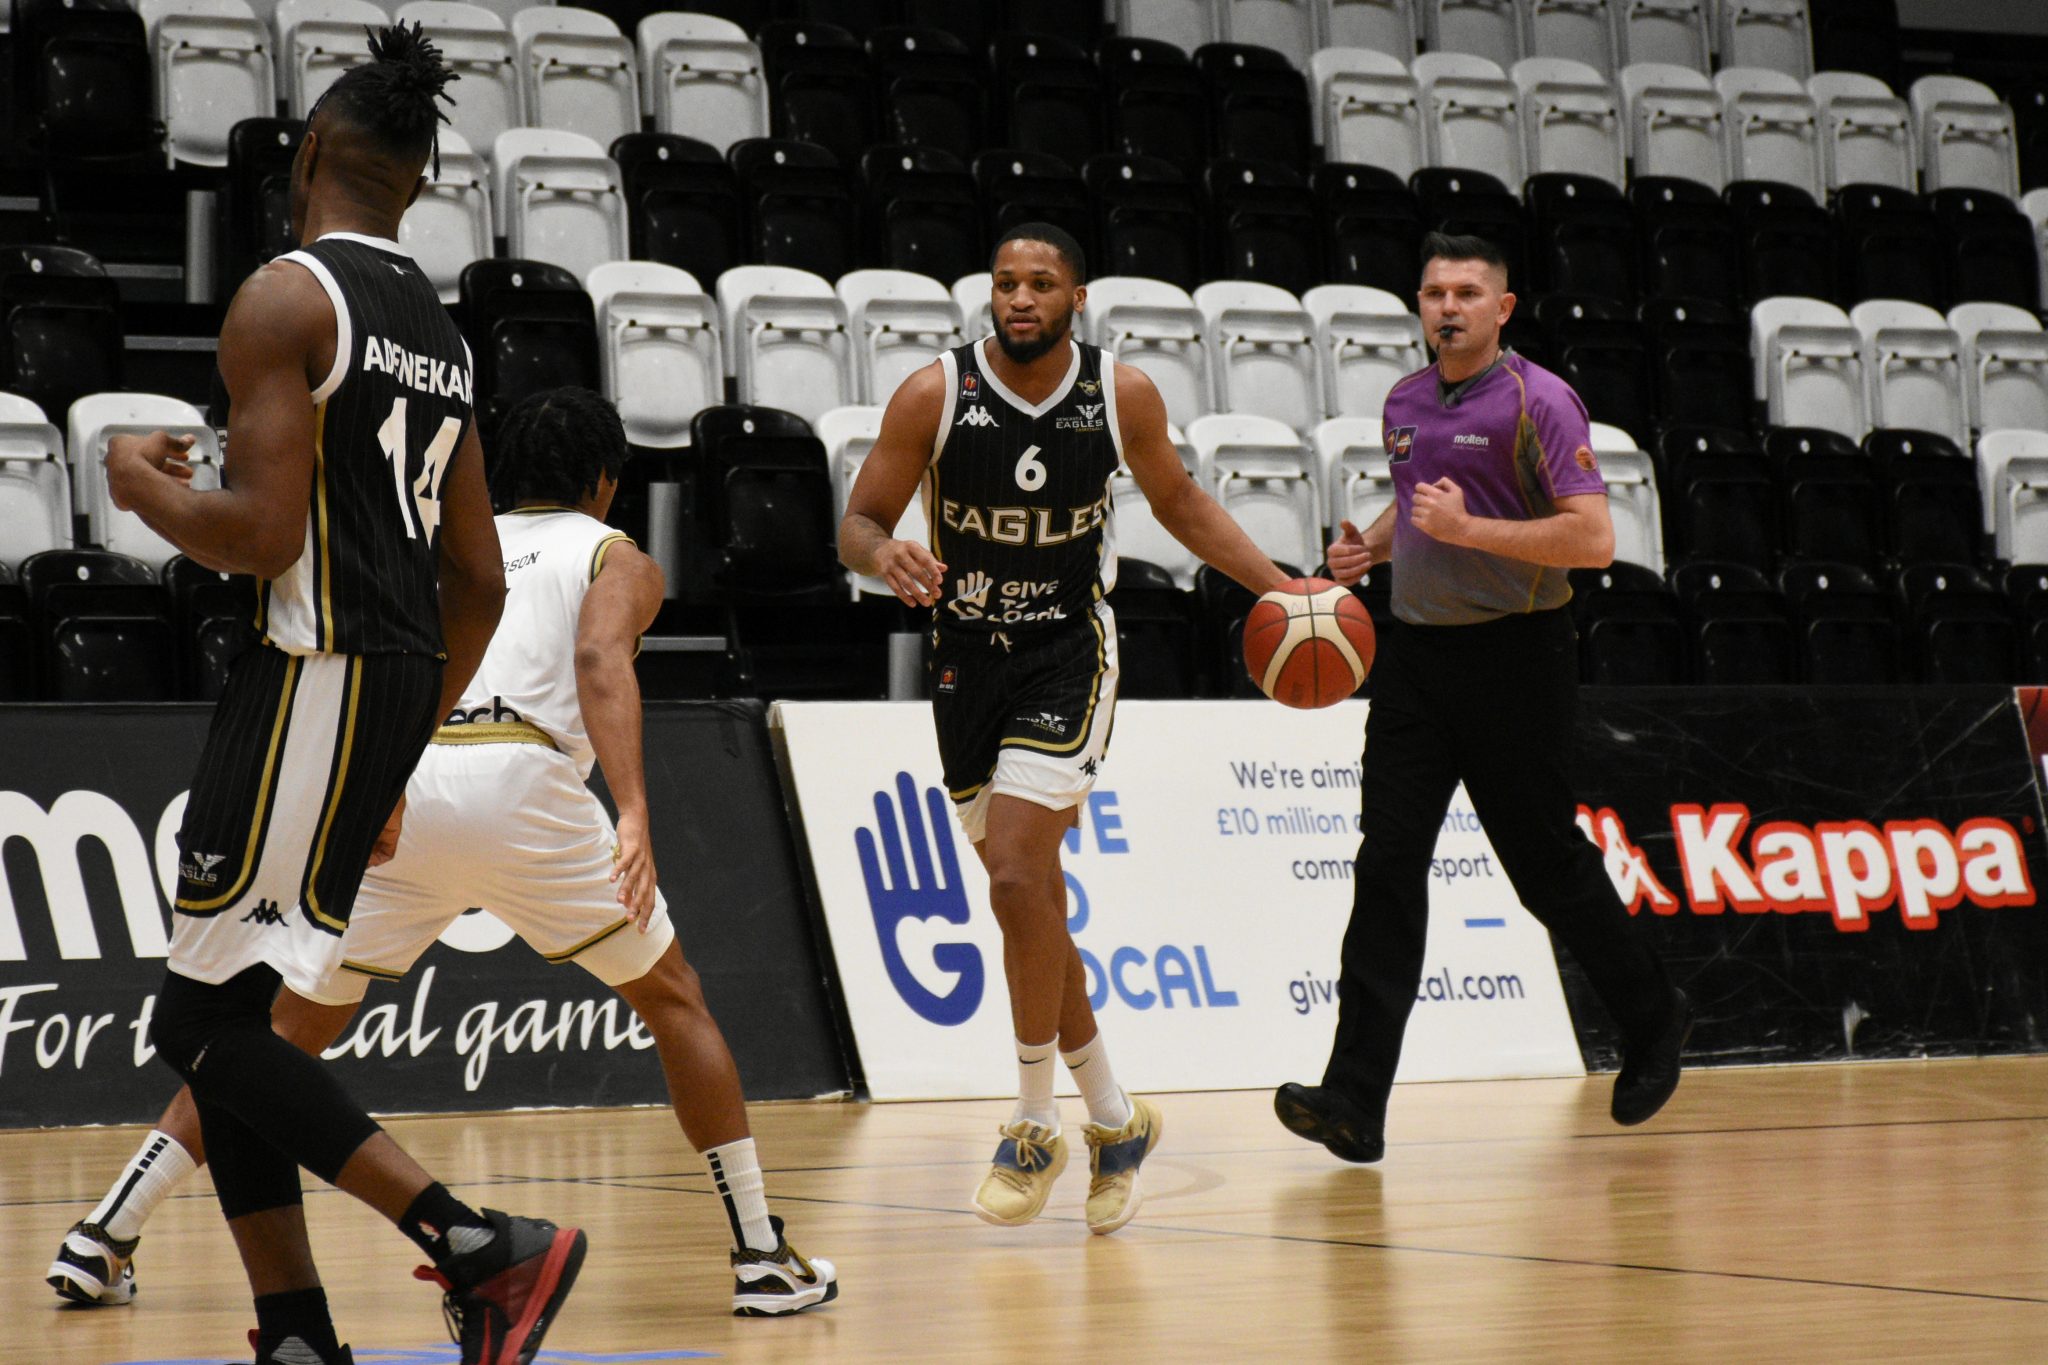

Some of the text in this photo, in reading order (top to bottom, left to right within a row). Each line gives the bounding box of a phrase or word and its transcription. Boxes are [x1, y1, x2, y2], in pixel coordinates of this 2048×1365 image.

[1056, 419, 1104, 429] EAGLES
[1454, 434, 1489, 446] molten
[377, 397, 461, 549] 14
[1015, 445, 1047, 492] 6
[1001, 580, 1059, 598] GIVE
[1230, 761, 1363, 789] We're aimi
[1217, 808, 1259, 836] £10
[1266, 807, 1348, 834] million
[1431, 853, 1493, 885] sport
[1676, 810, 2028, 920] Kappa
[0, 983, 115, 1078] For
